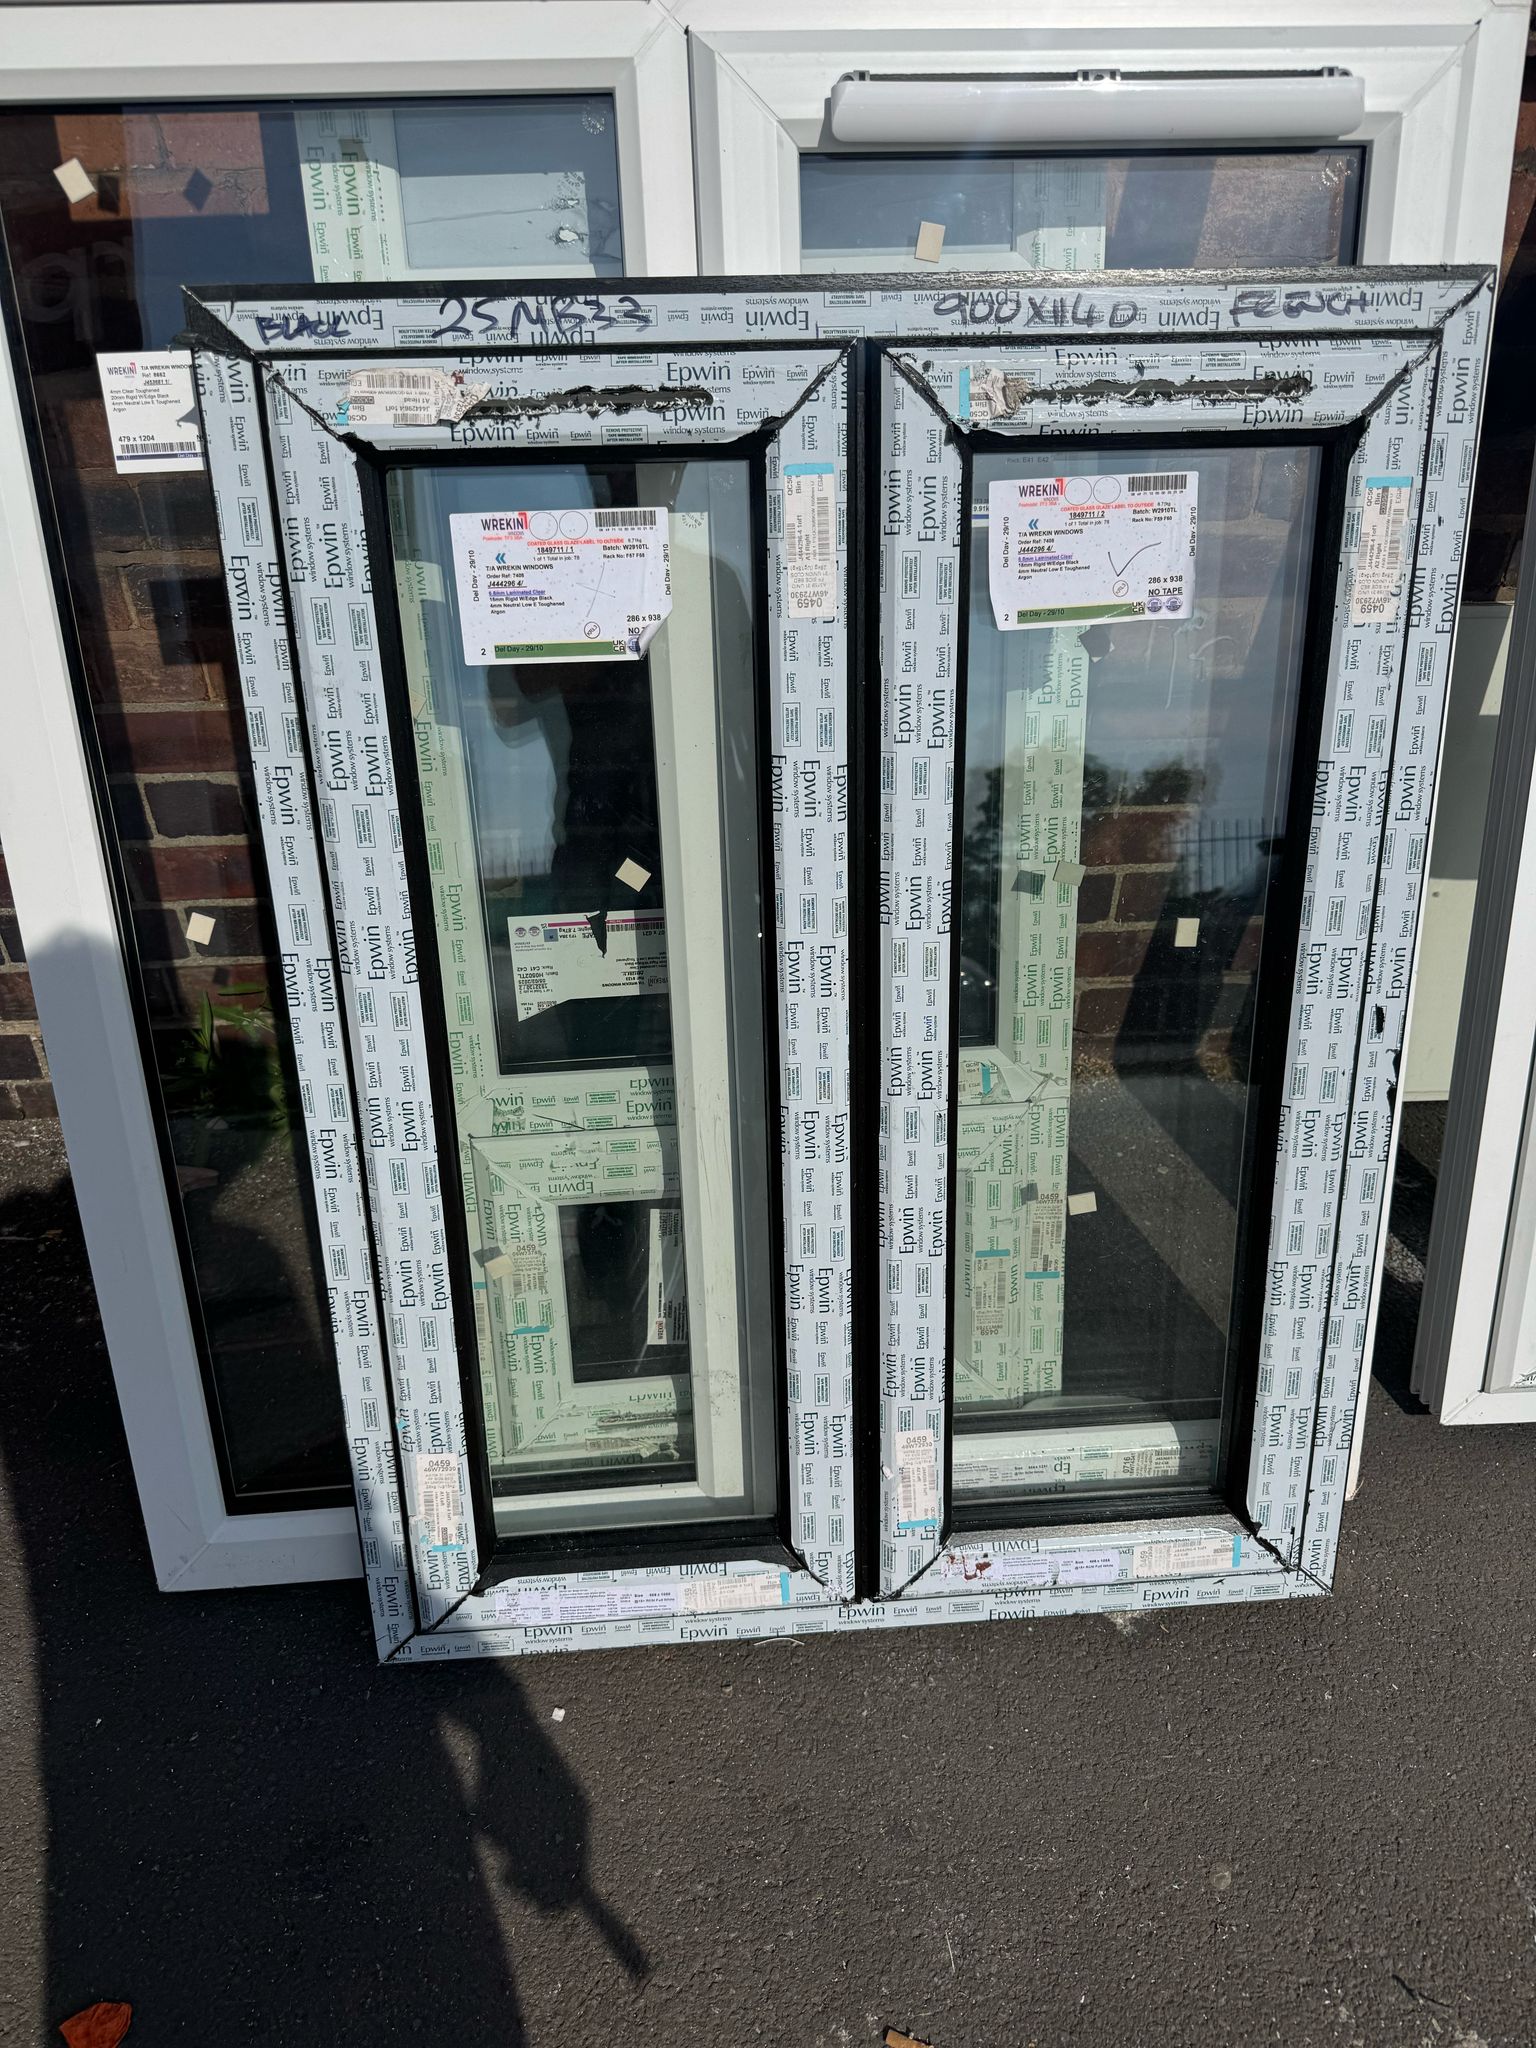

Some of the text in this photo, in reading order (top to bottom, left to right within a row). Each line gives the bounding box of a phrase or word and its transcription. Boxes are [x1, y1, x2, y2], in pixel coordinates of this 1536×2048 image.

[340, 152, 361, 216] Epwin
[746, 298, 774, 306] systems
[701, 311, 734, 324] Epwin
[746, 310, 809, 331] Epwin
[1463, 312, 1475, 345] Epwin
[107, 366, 134, 376] WREKIN
[1056, 349, 1117, 367] Epwin
[667, 362, 731, 382] Epwin
[743, 367, 775, 380] Epwin
[1056, 370, 1117, 379] window systems
[1323, 371, 1355, 384] Epwin
[1447, 357, 1470, 424] Epwin
[1469, 358, 1482, 424] window systems
[1243, 405, 1304, 424] Epwin
[451, 424, 514, 442] Epwin
[663, 425, 726, 434] window systems
[884, 469, 901, 536] Epwin
[1019, 484, 1059, 497] WREKIN
[918, 476, 936, 542] Epwin
[1069, 511, 1096, 519] 1849711
[481, 517, 524, 531] WREKIN
[285, 517, 306, 583] Epwin
[319, 523, 343, 589] Epwin
[537, 546, 564, 554] 1849711
[231, 555, 253, 621] Epwin
[1148, 587, 1183, 596] NO TAPE
[1169, 575, 1183, 583] 938
[797, 598, 823, 609] 0459
[1361, 603, 1385, 614] 0459
[1410, 567, 1427, 629] Epwin
[1436, 573, 1458, 634] Epwin
[480, 648, 486, 656] 2
[327, 730, 347, 791] Epwin
[365, 735, 384, 797] Epwin
[275, 766, 295, 825] Epwin
[800, 760, 820, 818] Epwin
[1345, 766, 1367, 822] Epwin
[1395, 765, 1417, 822] Epwin
[449, 884, 464, 931] Epwin
[905, 876, 922, 930] Epwin
[401, 1100, 420, 1151] Epwin
[802, 1110, 820, 1160] Epwin
[1305, 1110, 1321, 1158] Epwin
[1350, 1110, 1369, 1159] Epwin
[318, 1129, 338, 1179] Epwin
[1343, 1264, 1361, 1310] Epwin
[353, 1290, 370, 1337] Epwin
[911, 1357, 925, 1401] Epwin
[906, 1436, 927, 1444] 0459
[429, 1459, 451, 1468] 0459
[1142, 1588, 1189, 1602] Epwin
[989, 1607, 1035, 1621] Epwin
[524, 1625, 573, 1638] Epwin
[680, 1625, 727, 1641] Epwin
